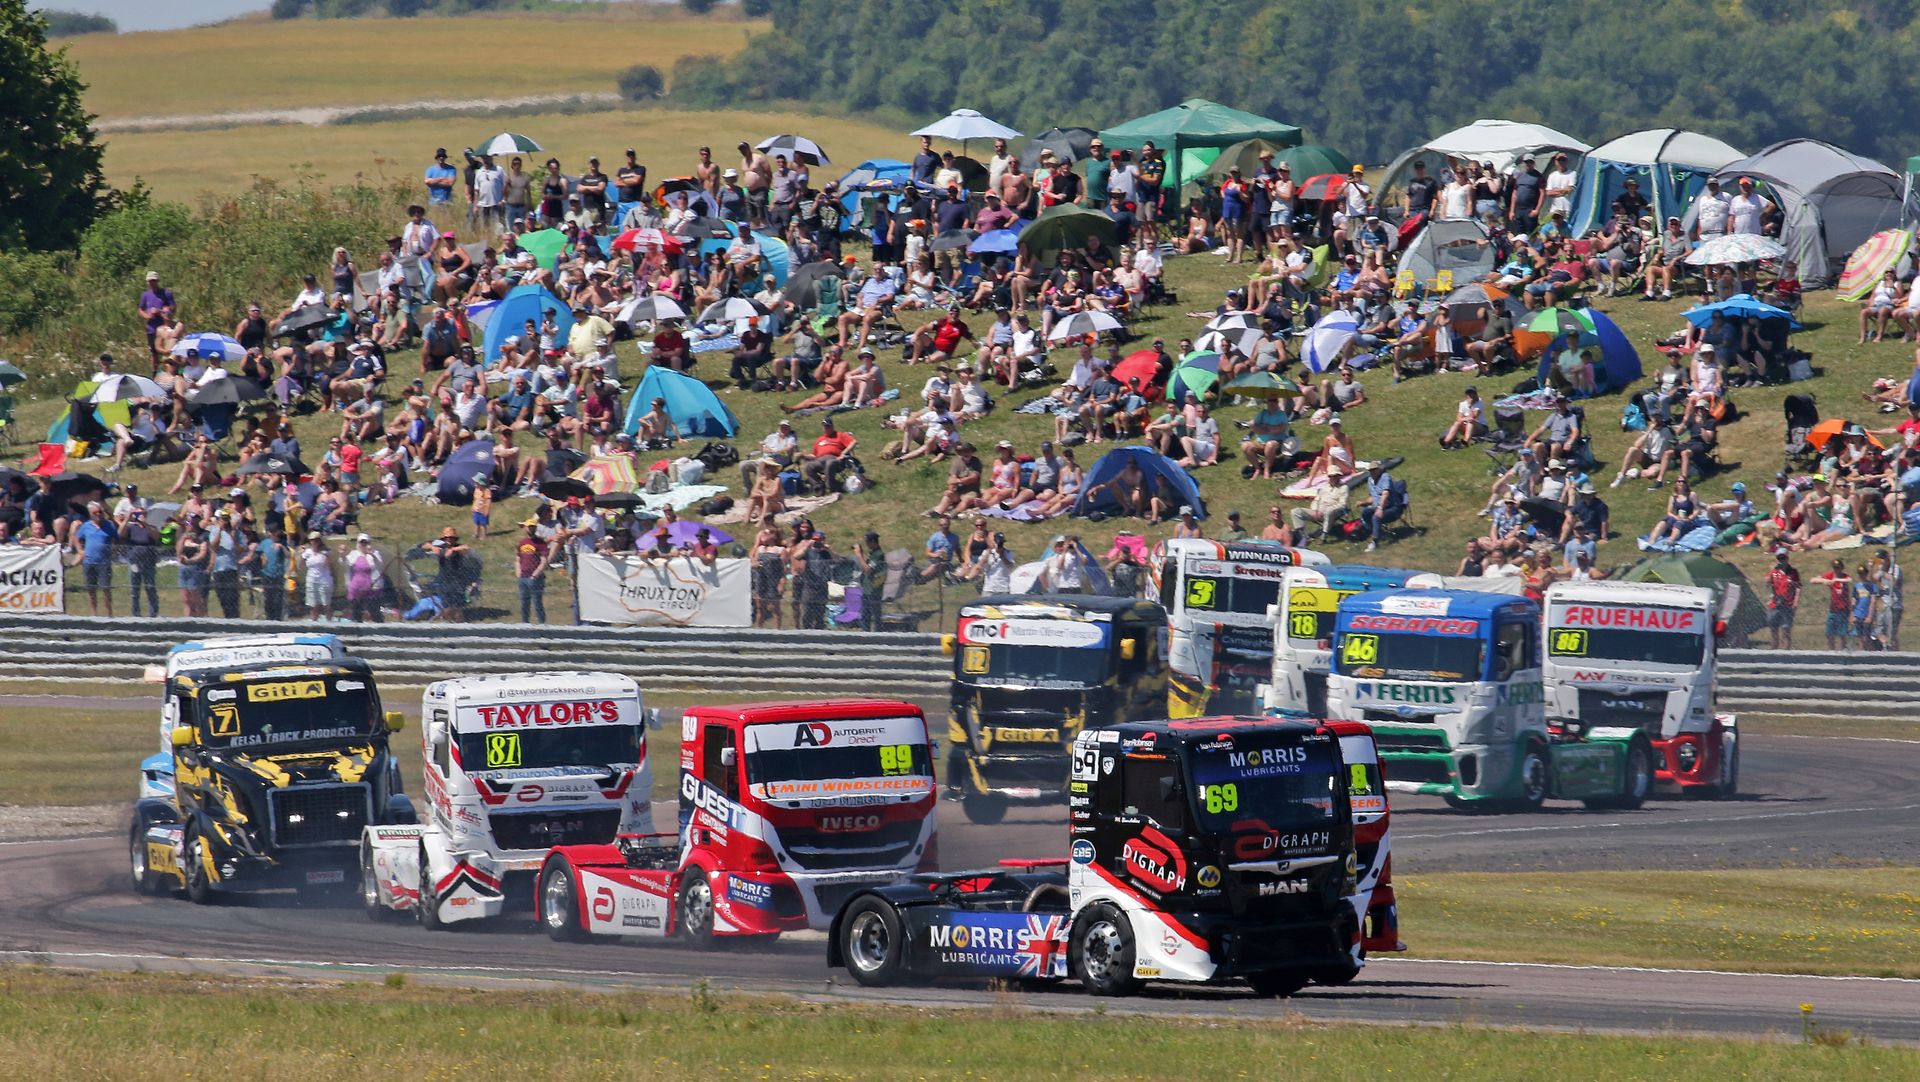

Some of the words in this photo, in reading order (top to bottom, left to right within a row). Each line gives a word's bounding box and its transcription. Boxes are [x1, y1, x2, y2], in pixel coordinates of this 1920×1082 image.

[1228, 551, 1291, 563] WINNARD
[0, 569, 57, 586] ACING
[1234, 565, 1281, 578] Screentek
[619, 584, 699, 602] THRUXTON
[1189, 582, 1213, 604] 3
[1292, 615, 1314, 635] 18
[1350, 615, 1479, 634] SCRAPCO
[1565, 606, 1693, 629] FRUEHAUF
[1346, 638, 1377, 660] 46
[1557, 633, 1580, 650] 86
[233, 648, 263, 660] Truck
[268, 649, 275, 658] &
[279, 648, 299, 659] Van
[304, 649, 322, 659] Ltd
[254, 686, 298, 698] Giti
[214, 710, 233, 733] 7
[477, 700, 619, 728] TAYLOR'S
[230, 734, 262, 747] KELSA
[303, 726, 357, 740] PRODUCTS
[794, 722, 832, 747] AD
[834, 727, 885, 738] AUTOBRITE
[848, 735, 878, 745] Direct
[489, 735, 518, 765] 81
[880, 744, 912, 769] 89
[1229, 747, 1307, 767] MORRIS
[1074, 750, 1096, 774] 69
[1240, 764, 1301, 777] LUBRICANTS
[758, 783, 817, 795] GEMINI
[822, 779, 929, 792] WINDSCREENS
[682, 773, 742, 828] GUEST
[1207, 784, 1238, 814] 69
[823, 815, 879, 830] IVECO
[1263, 832, 1330, 849] DIGRAPH
[1122, 844, 1186, 891] DIGRAPH
[729, 876, 771, 897] MORRIS
[1259, 879, 1308, 896] MAN
[930, 926, 1031, 950] MORRIS
[942, 953, 1021, 965] LUBRICANTS
